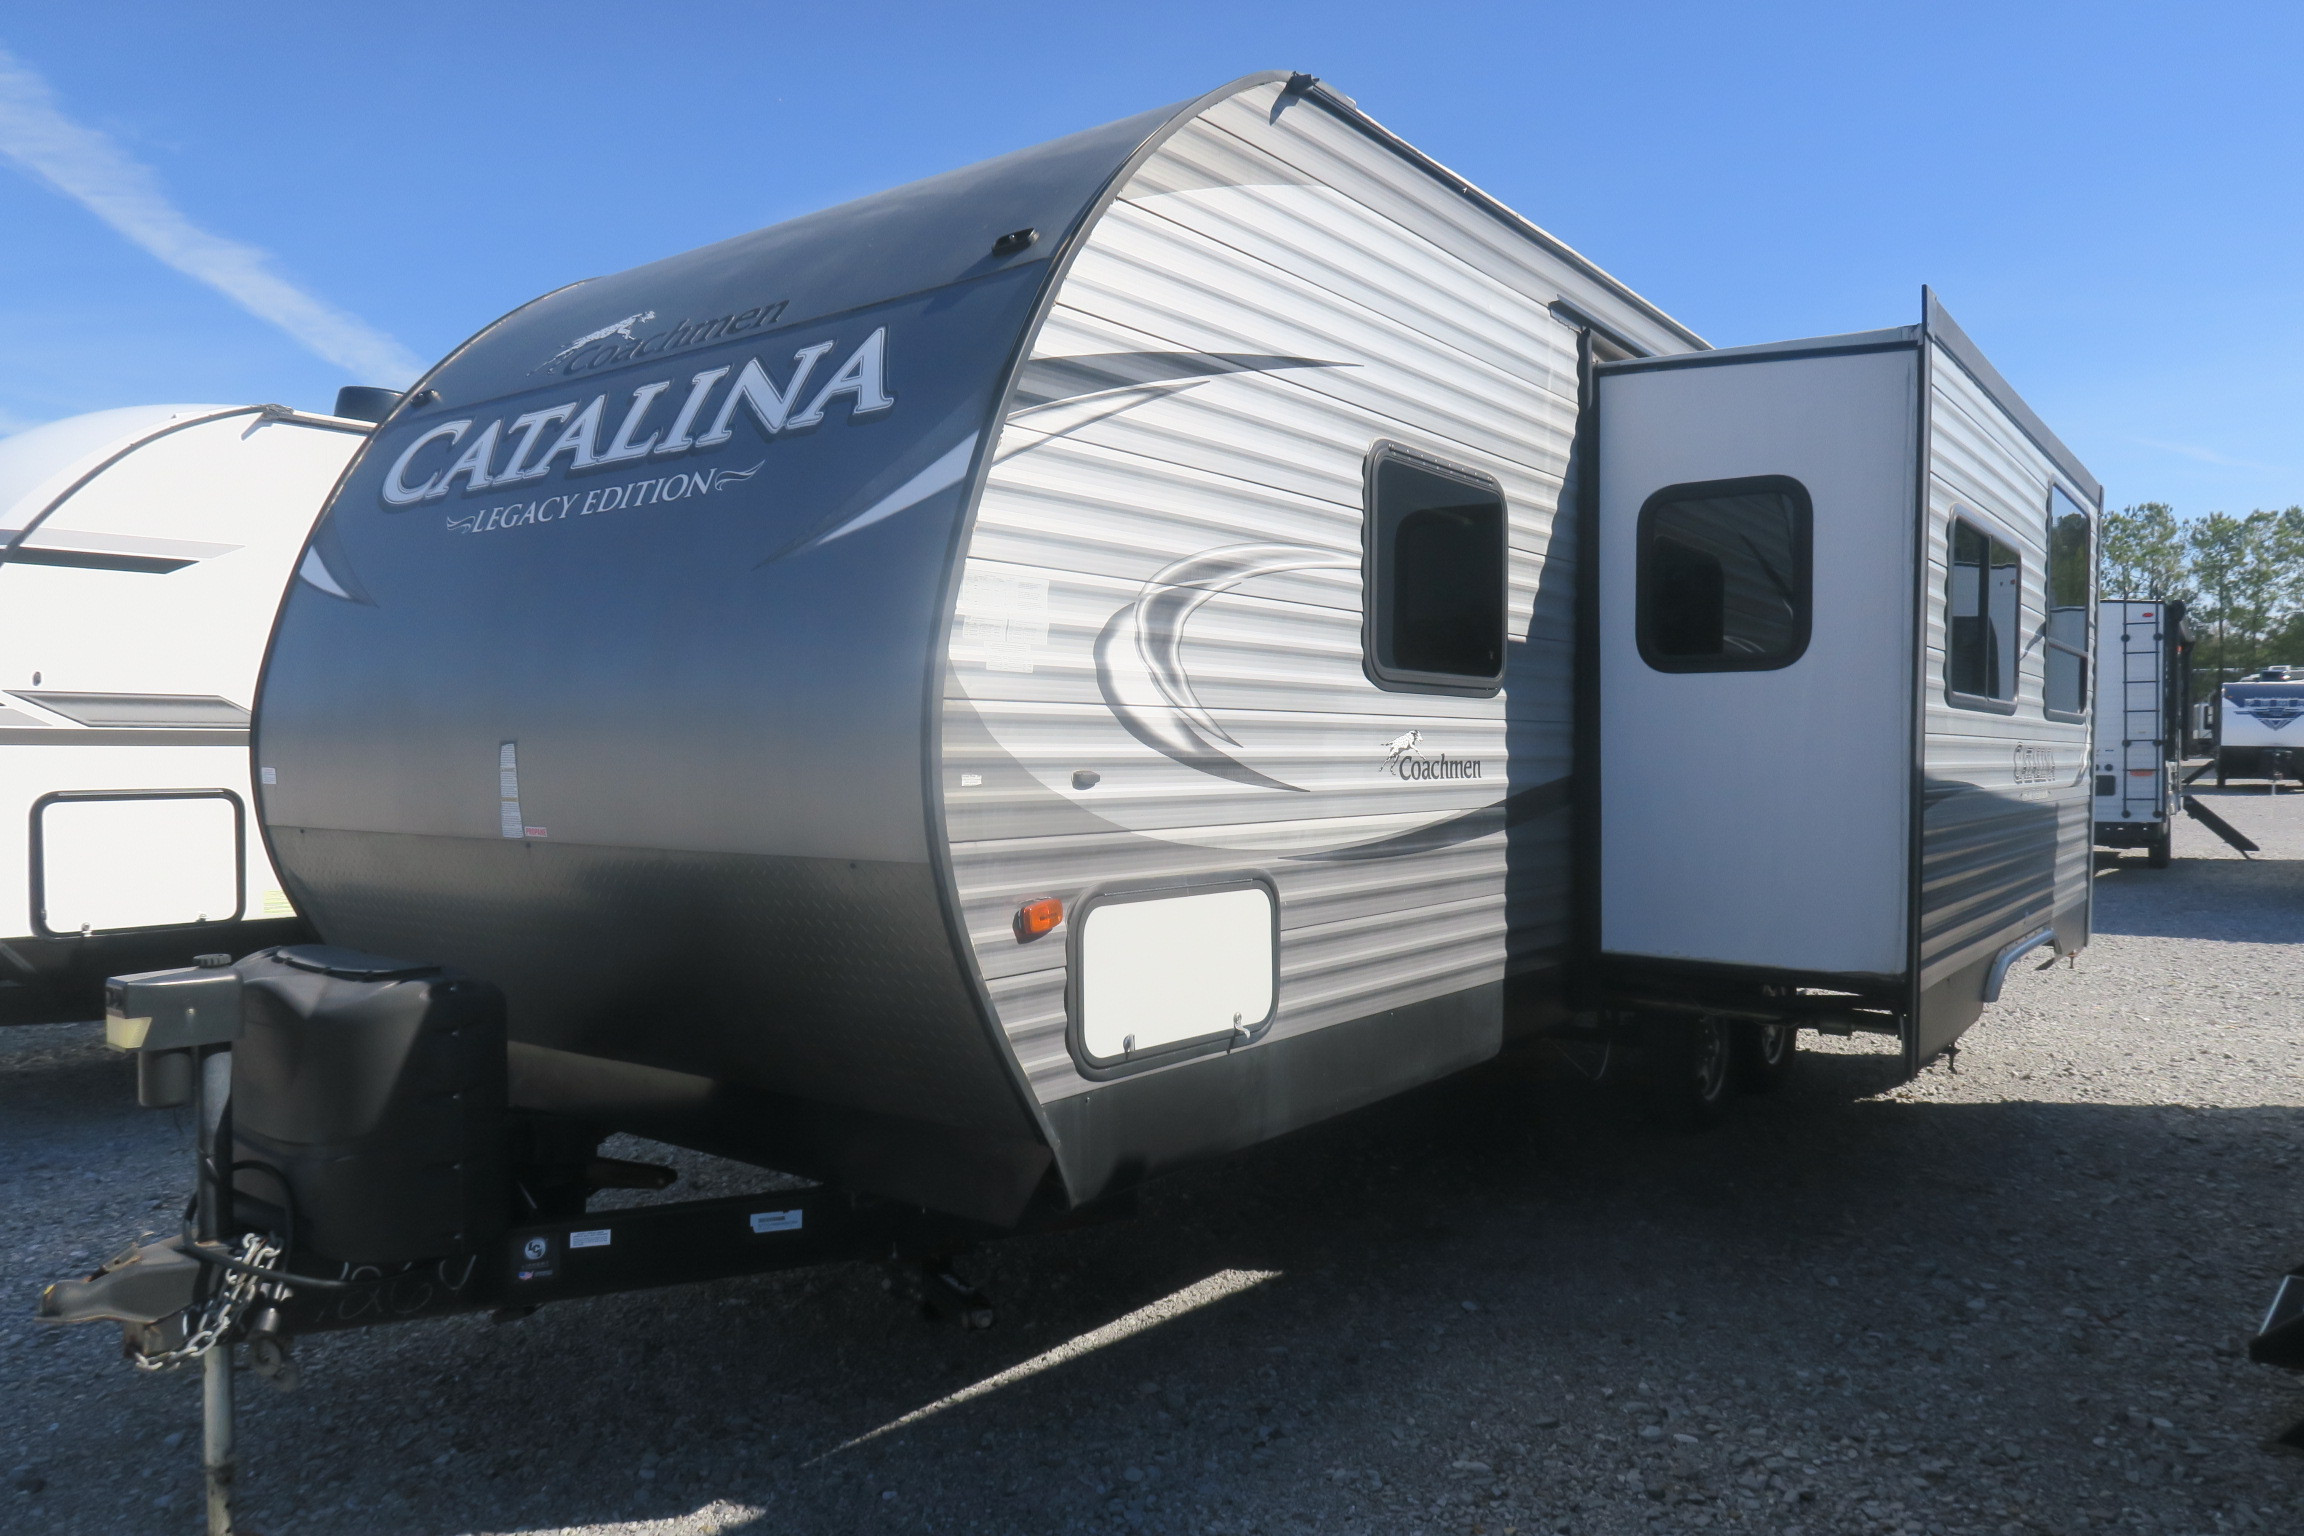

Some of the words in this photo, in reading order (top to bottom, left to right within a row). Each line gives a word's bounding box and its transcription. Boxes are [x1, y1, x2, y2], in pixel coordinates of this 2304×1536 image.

[563, 300, 790, 375] Coachmen
[382, 326, 895, 505] CATALINA
[472, 493, 584, 533] LEGACY
[581, 467, 717, 516] EDITION
[1400, 753, 1482, 780] Coachmen
